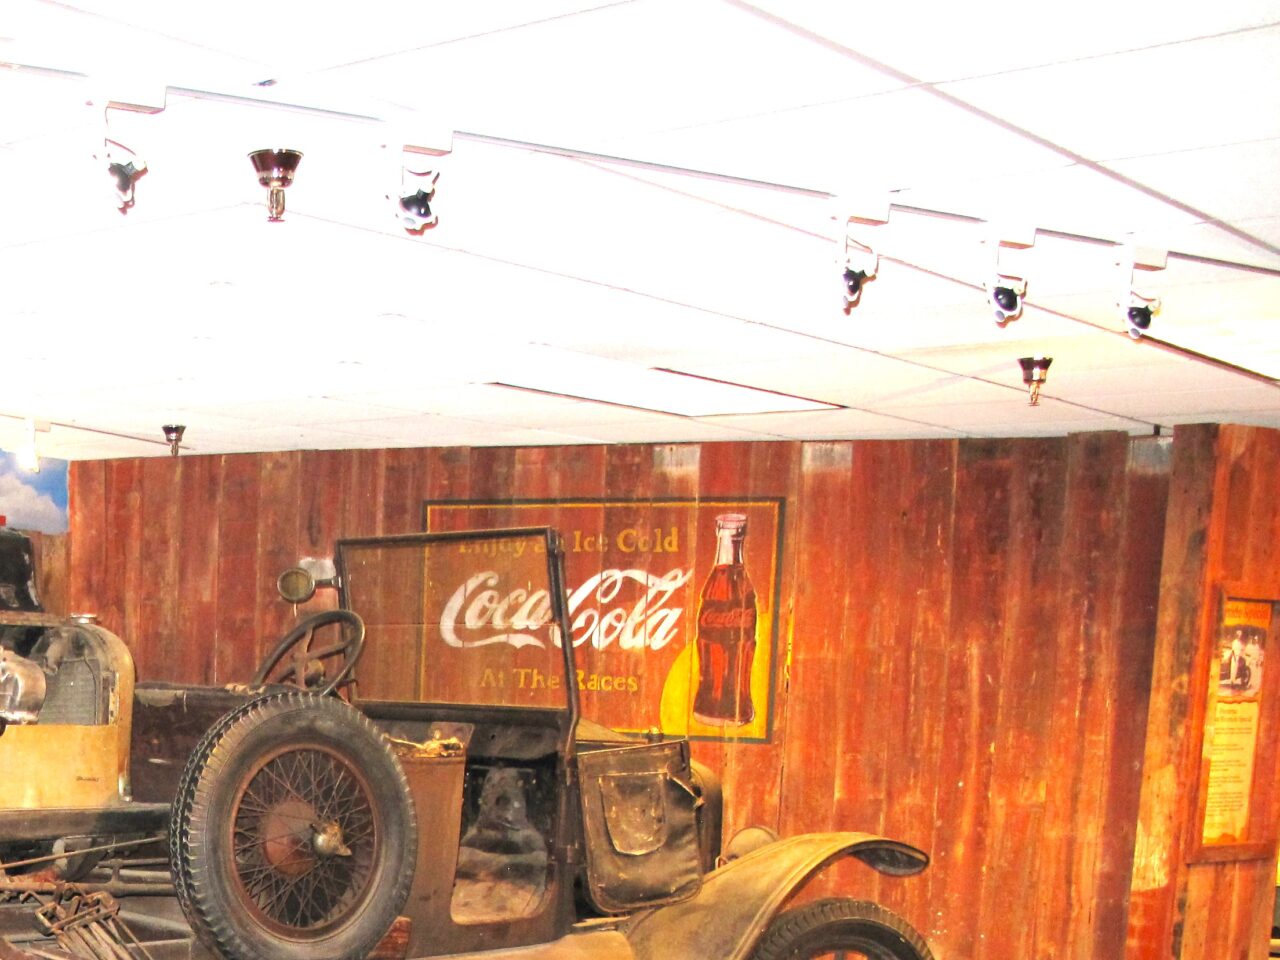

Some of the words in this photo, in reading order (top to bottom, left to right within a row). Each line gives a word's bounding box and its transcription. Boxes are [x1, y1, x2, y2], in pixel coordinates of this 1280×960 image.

[573, 531, 609, 553] Ice
[617, 527, 679, 553] Cold
[480, 668, 504, 688] At
[513, 668, 560, 690] The
[575, 669, 639, 692] Races
